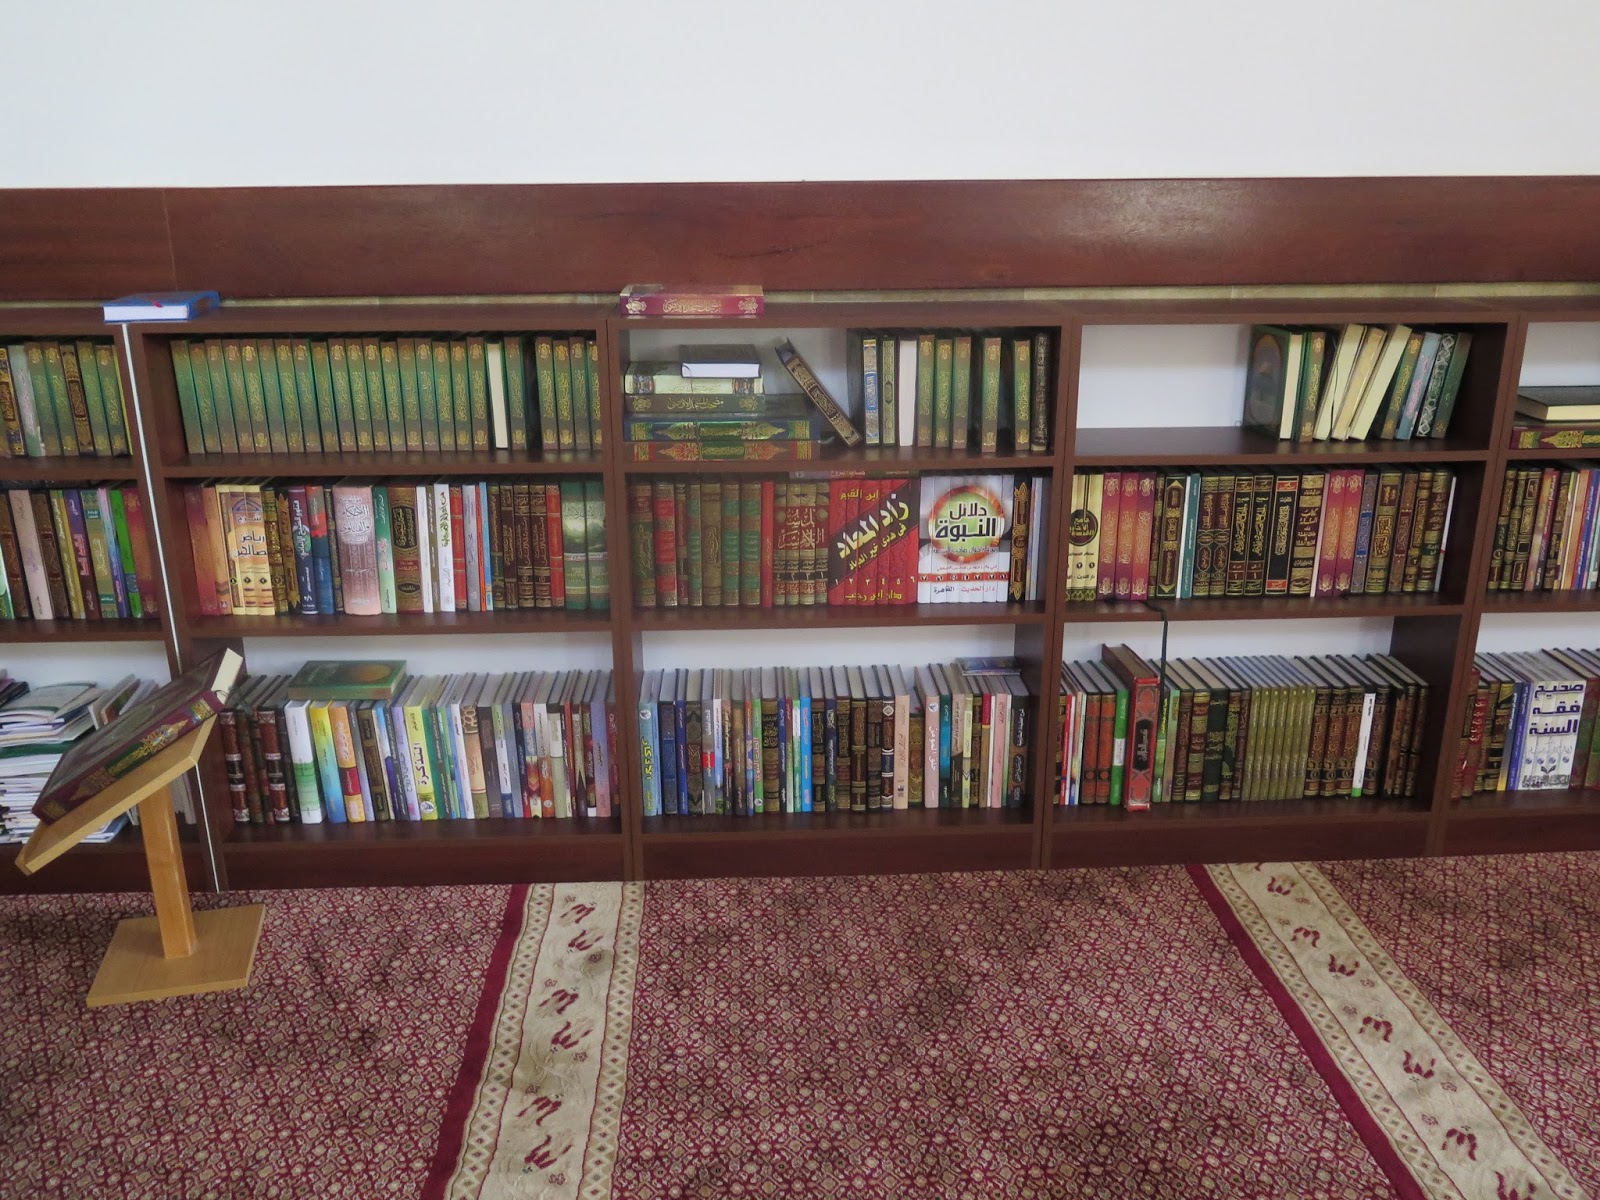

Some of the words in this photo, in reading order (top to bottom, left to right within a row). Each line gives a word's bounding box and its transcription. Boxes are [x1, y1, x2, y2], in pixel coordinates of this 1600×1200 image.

[840, 488, 862, 500] القيم
[866, 489, 879, 502] ابن
[880, 493, 910, 527] زاد
[949, 502, 987, 520] دلائل
[240, 531, 265, 542] رياض
[836, 514, 880, 560] المعاد
[935, 518, 996, 542] النبوة
[888, 590, 902, 600] دار
[933, 586, 955, 594] القاهرة
[1534, 684, 1584, 699] صحيح
[1532, 700, 1581, 715] فقه
[1528, 719, 1579, 735] السنة
[413, 742, 430, 786] التذكرة
